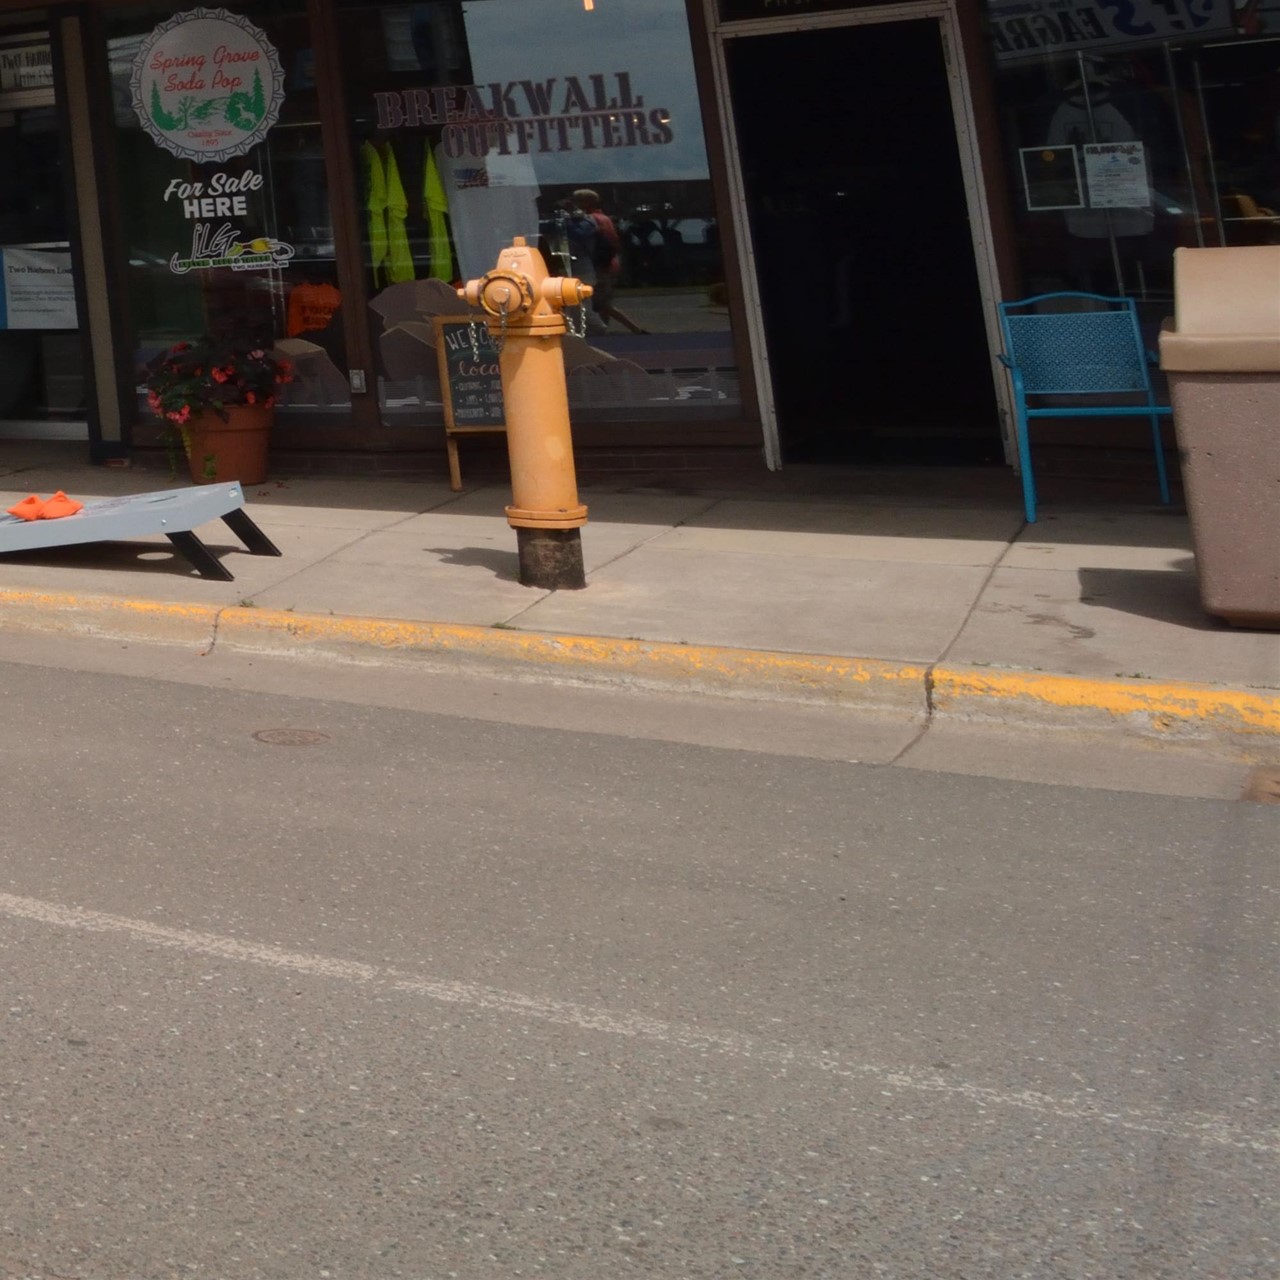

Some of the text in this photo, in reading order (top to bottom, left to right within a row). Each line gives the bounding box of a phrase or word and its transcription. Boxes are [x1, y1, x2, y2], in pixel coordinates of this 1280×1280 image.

[149, 45, 261, 75] Spring Grove
[164, 70, 242, 93] Soda Pop
[373, 71, 644, 129] BREAKWALL
[440, 107, 674, 159] OUTFITTERS
[163, 169, 265, 202] For Sale
[183, 195, 248, 219] HERE
